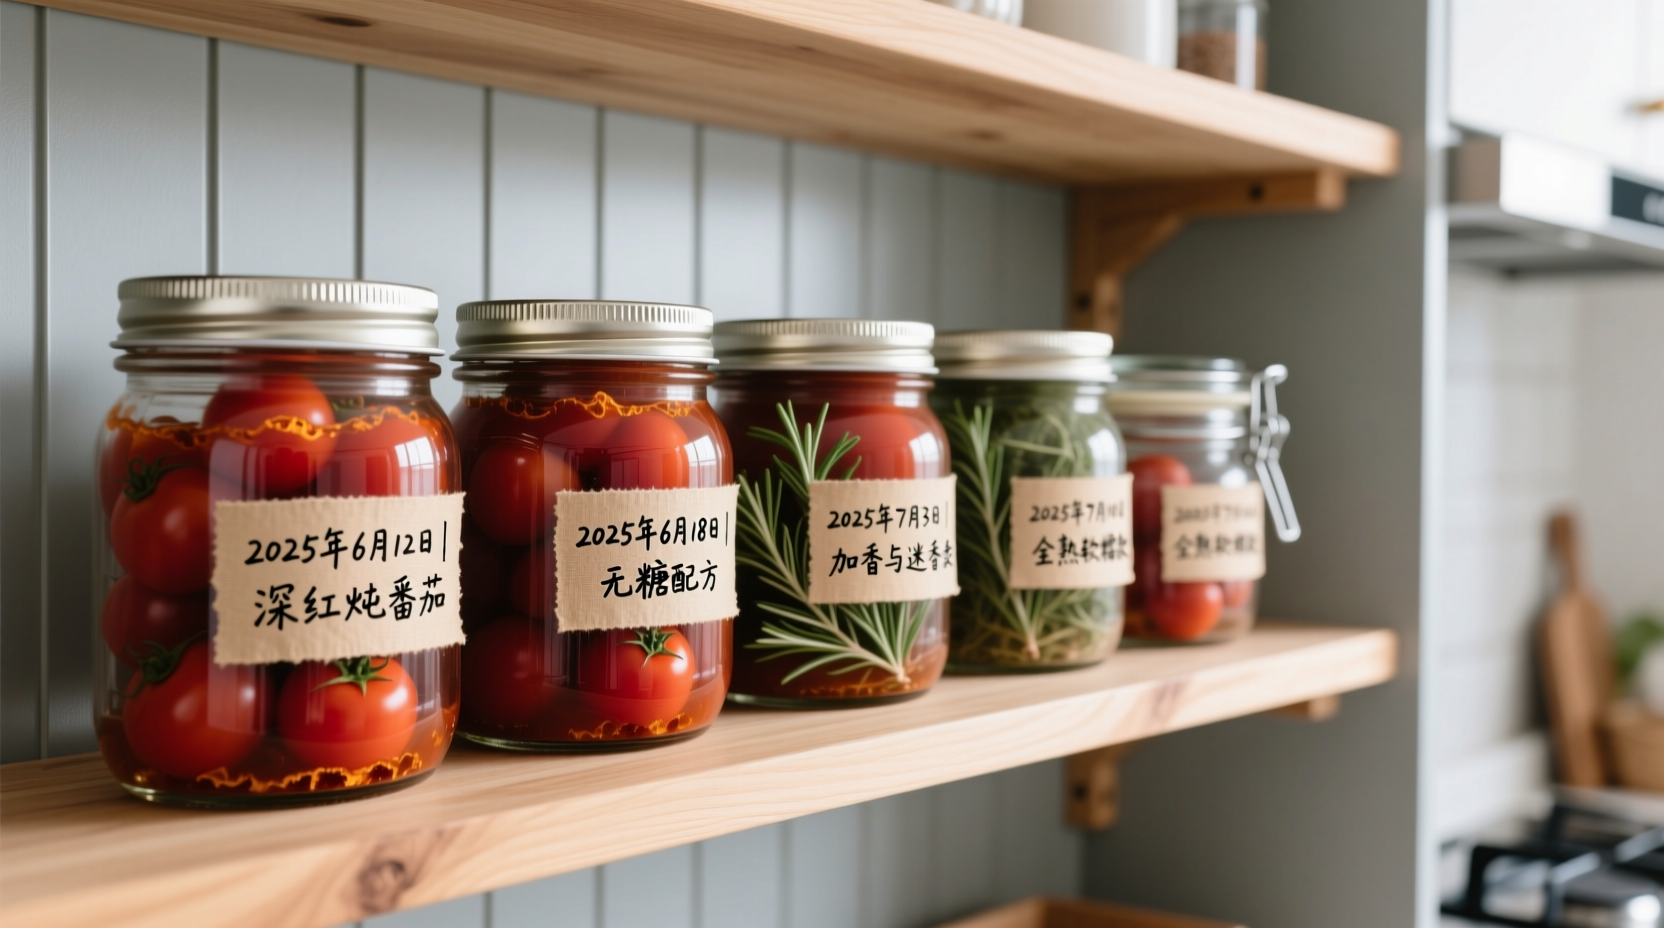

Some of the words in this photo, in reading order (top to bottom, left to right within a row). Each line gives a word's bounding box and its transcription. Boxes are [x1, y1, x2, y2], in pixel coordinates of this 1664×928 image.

[254, 573, 446, 631] 深红炖番茄
[601, 559, 718, 600] 无糖配方
